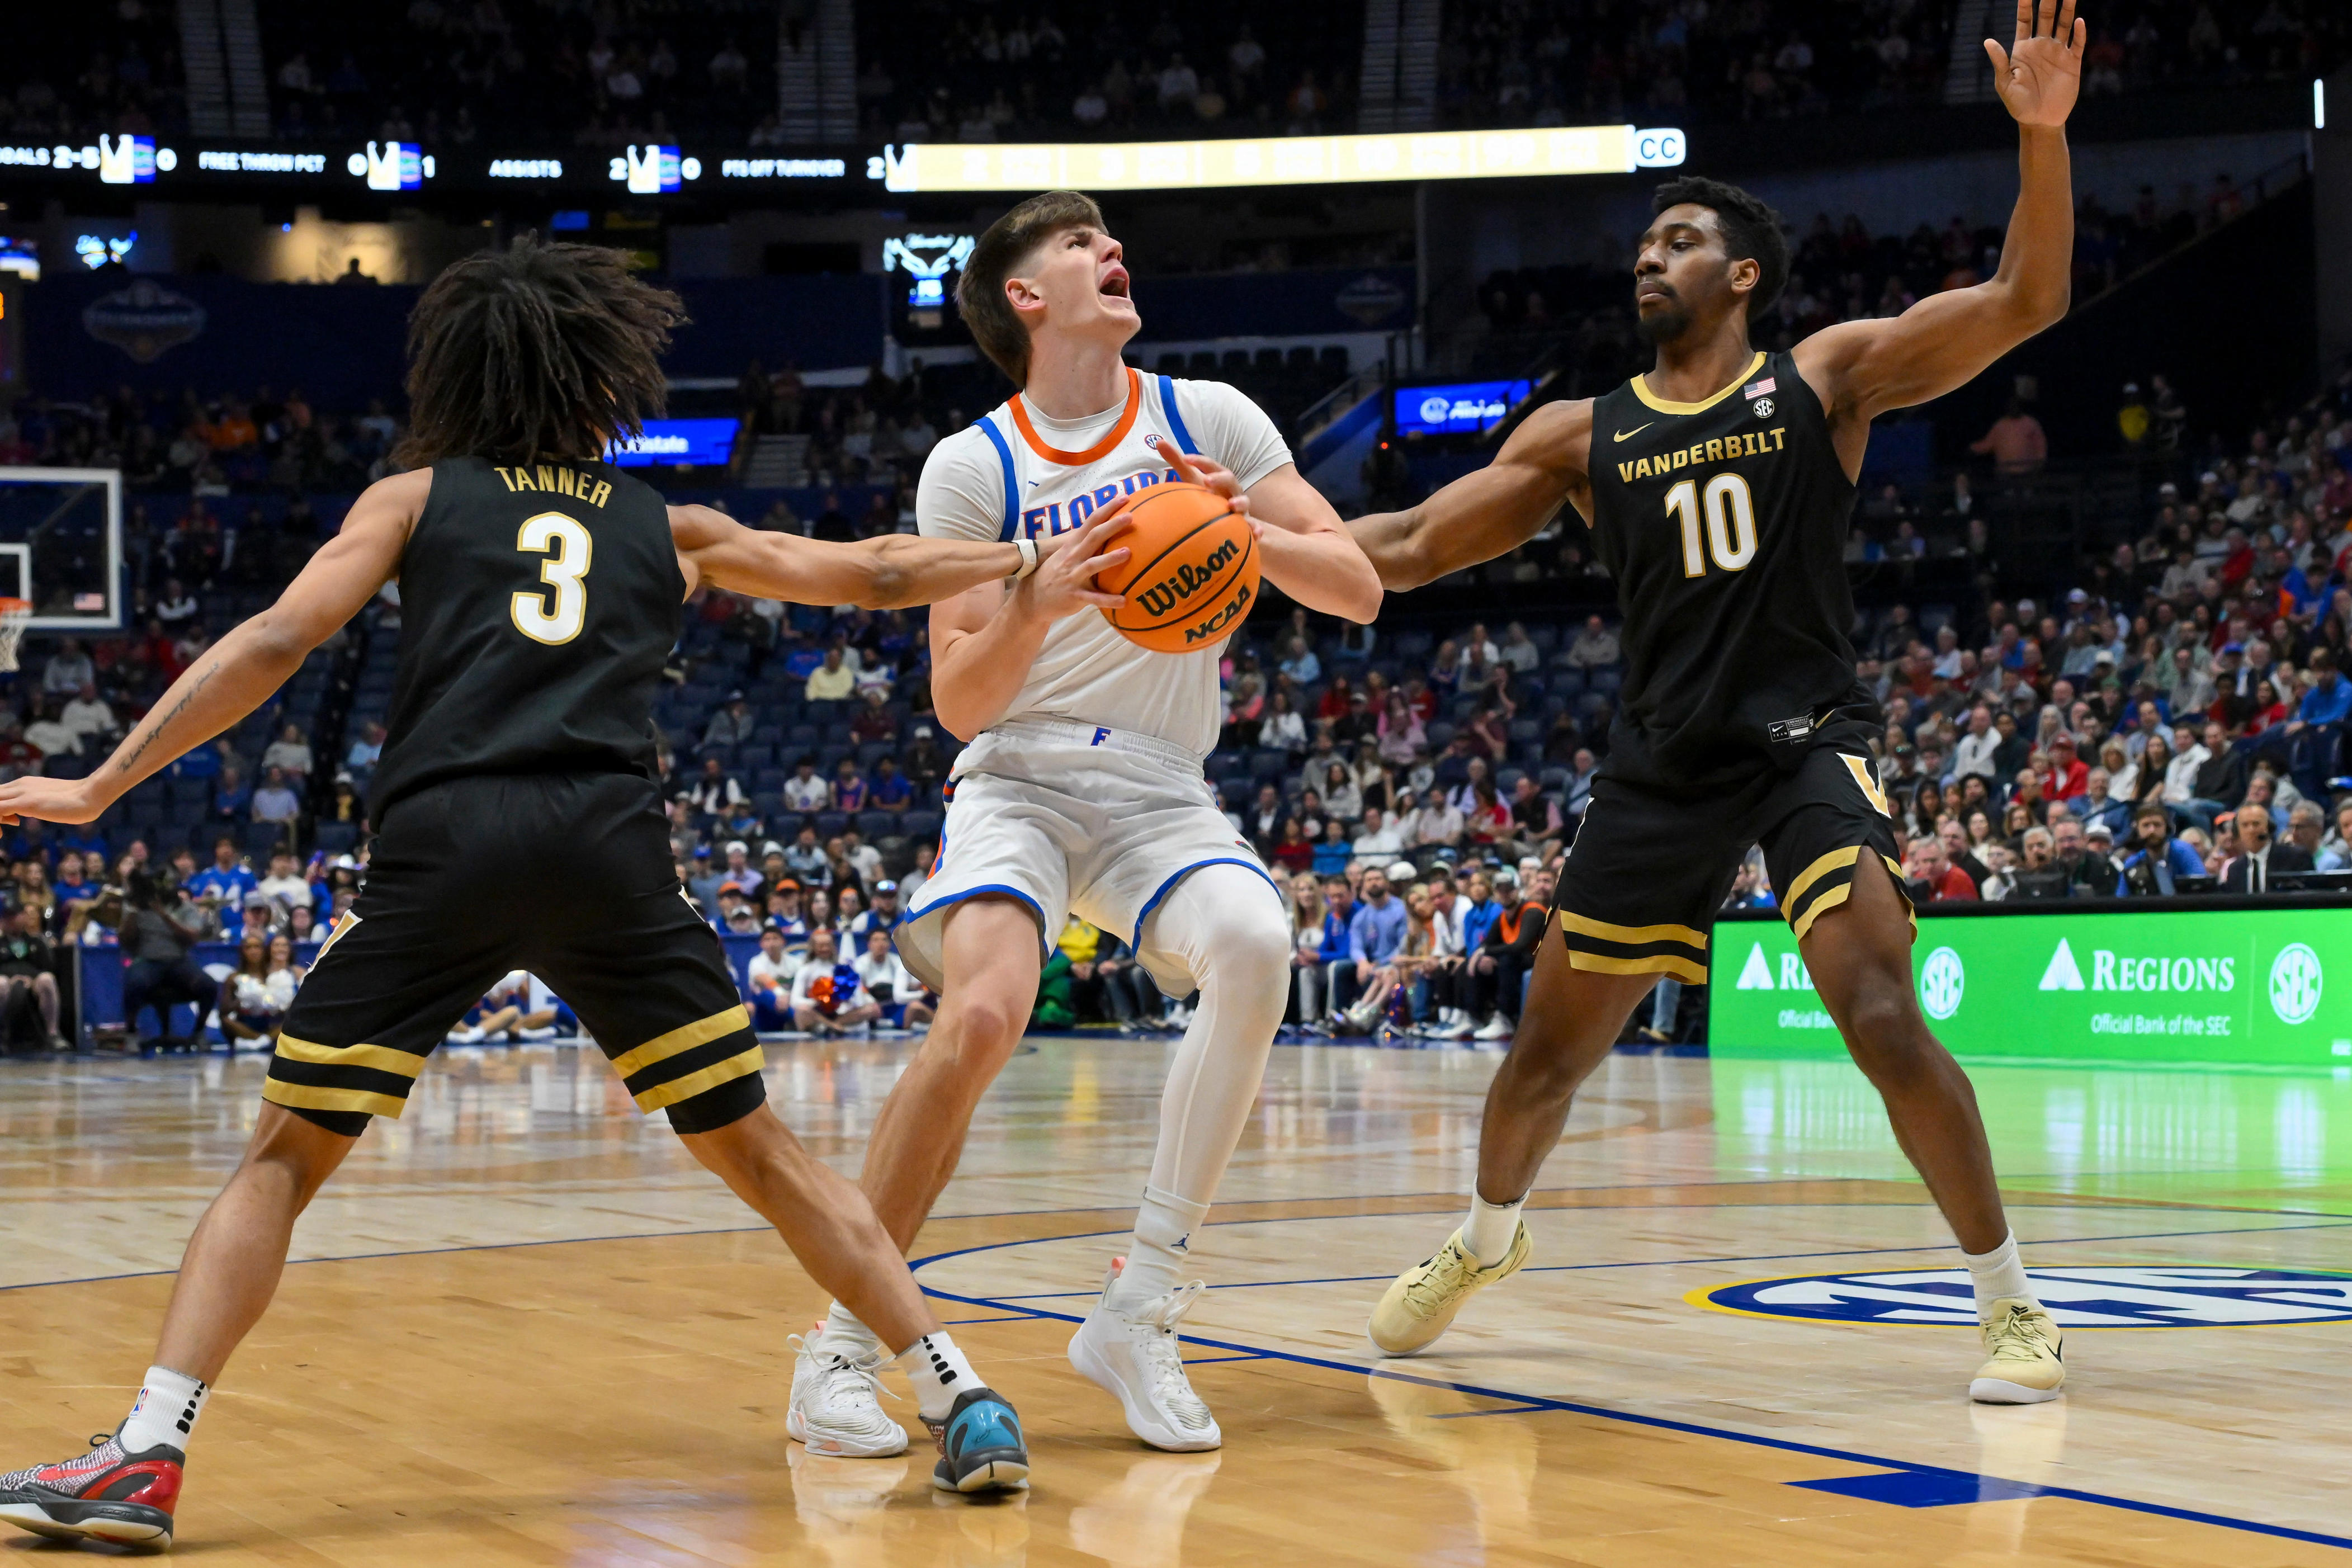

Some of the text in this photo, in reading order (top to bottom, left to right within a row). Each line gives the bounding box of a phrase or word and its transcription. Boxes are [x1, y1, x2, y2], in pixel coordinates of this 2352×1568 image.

[0, 148, 49, 165] OALS
[200, 152, 239, 170] FREE
[295, 155, 325, 172] PCT
[489, 160, 561, 177] ASSISTS
[1641, 138, 1676, 159] CC
[1755, 400, 1772, 416] SEC
[1618, 427, 1786, 483] VANDERBILT
[494, 465, 612, 508] TANNER
[1664, 473, 1759, 578] 10
[511, 511, 593, 645] 3
[1136, 539, 1240, 616] Wilson
[1184, 583, 1251, 643] NCAA
[1090, 727, 1112, 746] F
[1922, 951, 1962, 1014] SEC
[2091, 950, 2235, 991] REGIONS
[2273, 948, 2318, 1019] SEC
[1778, 1010, 1813, 1028] Official
[2090, 1013, 2232, 1035] Official Bank of the SEC
